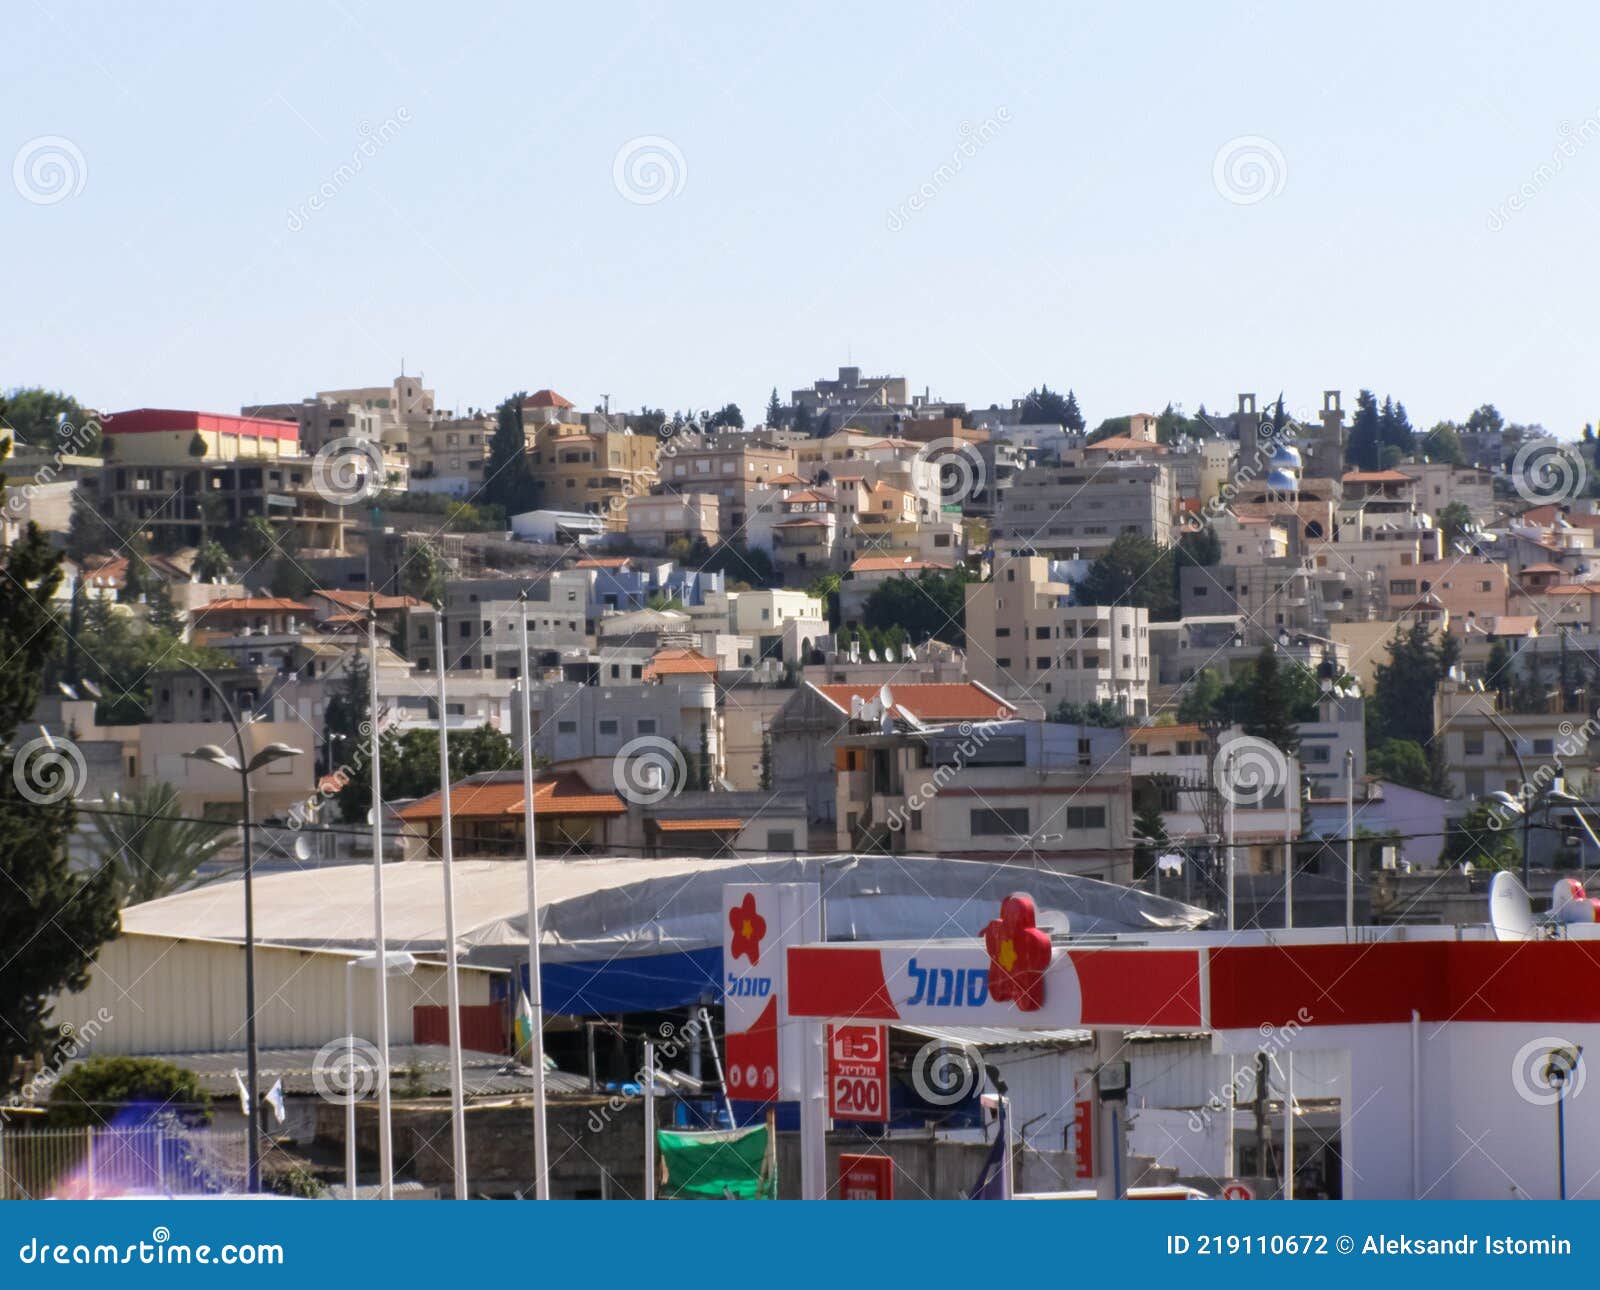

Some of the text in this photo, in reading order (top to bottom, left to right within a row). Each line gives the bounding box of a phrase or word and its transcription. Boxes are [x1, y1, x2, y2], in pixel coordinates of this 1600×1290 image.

[727, 972, 771, 997] סונול
[907, 957, 990, 1007] סונול
[837, 1079, 880, 1112] 200
